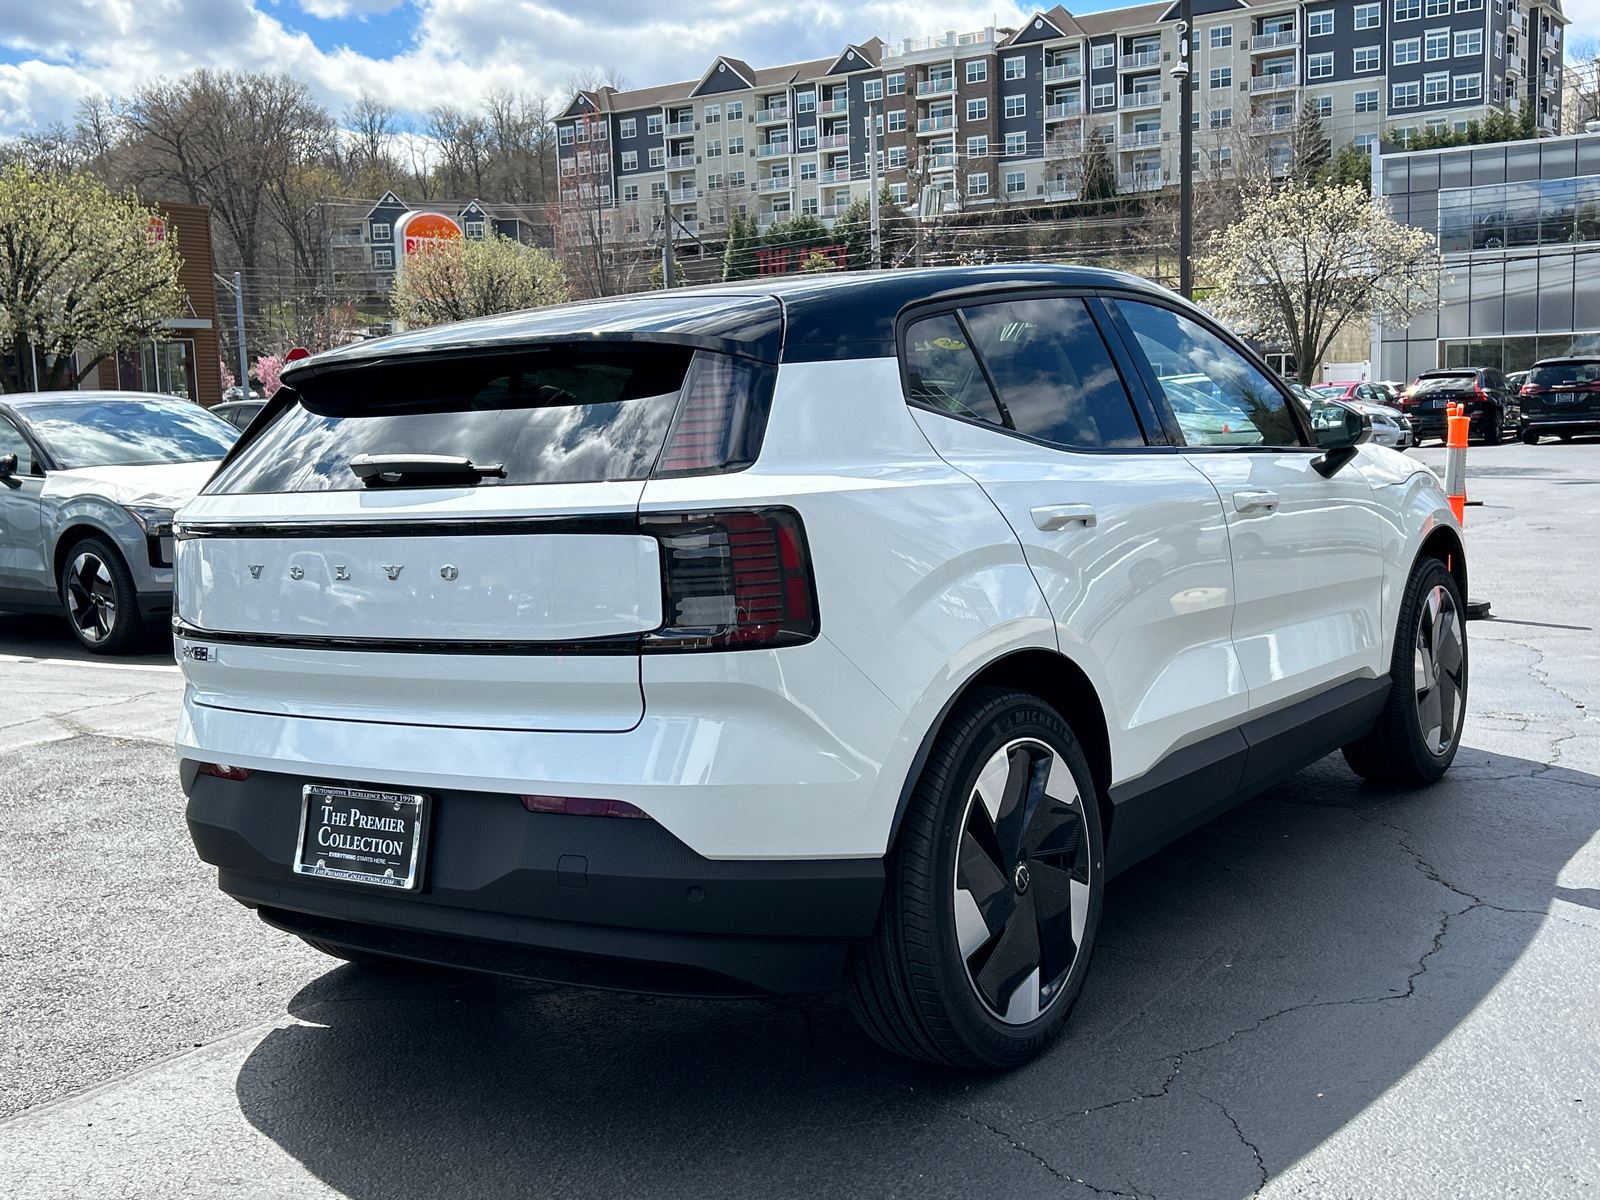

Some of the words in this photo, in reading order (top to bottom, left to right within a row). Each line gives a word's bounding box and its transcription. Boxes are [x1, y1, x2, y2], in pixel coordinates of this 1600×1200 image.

[248, 564, 459, 581] VOLVO
[1015, 710, 1070, 743] MICHELIN
[399, 795, 415, 803] 1995
[321, 805, 347, 827] THE
[348, 808, 405, 833] PREMIER
[318, 827, 403, 855] COLLECTION
[328, 851, 357, 861] EVERYTHING
[356, 855, 374, 863] STARTS
